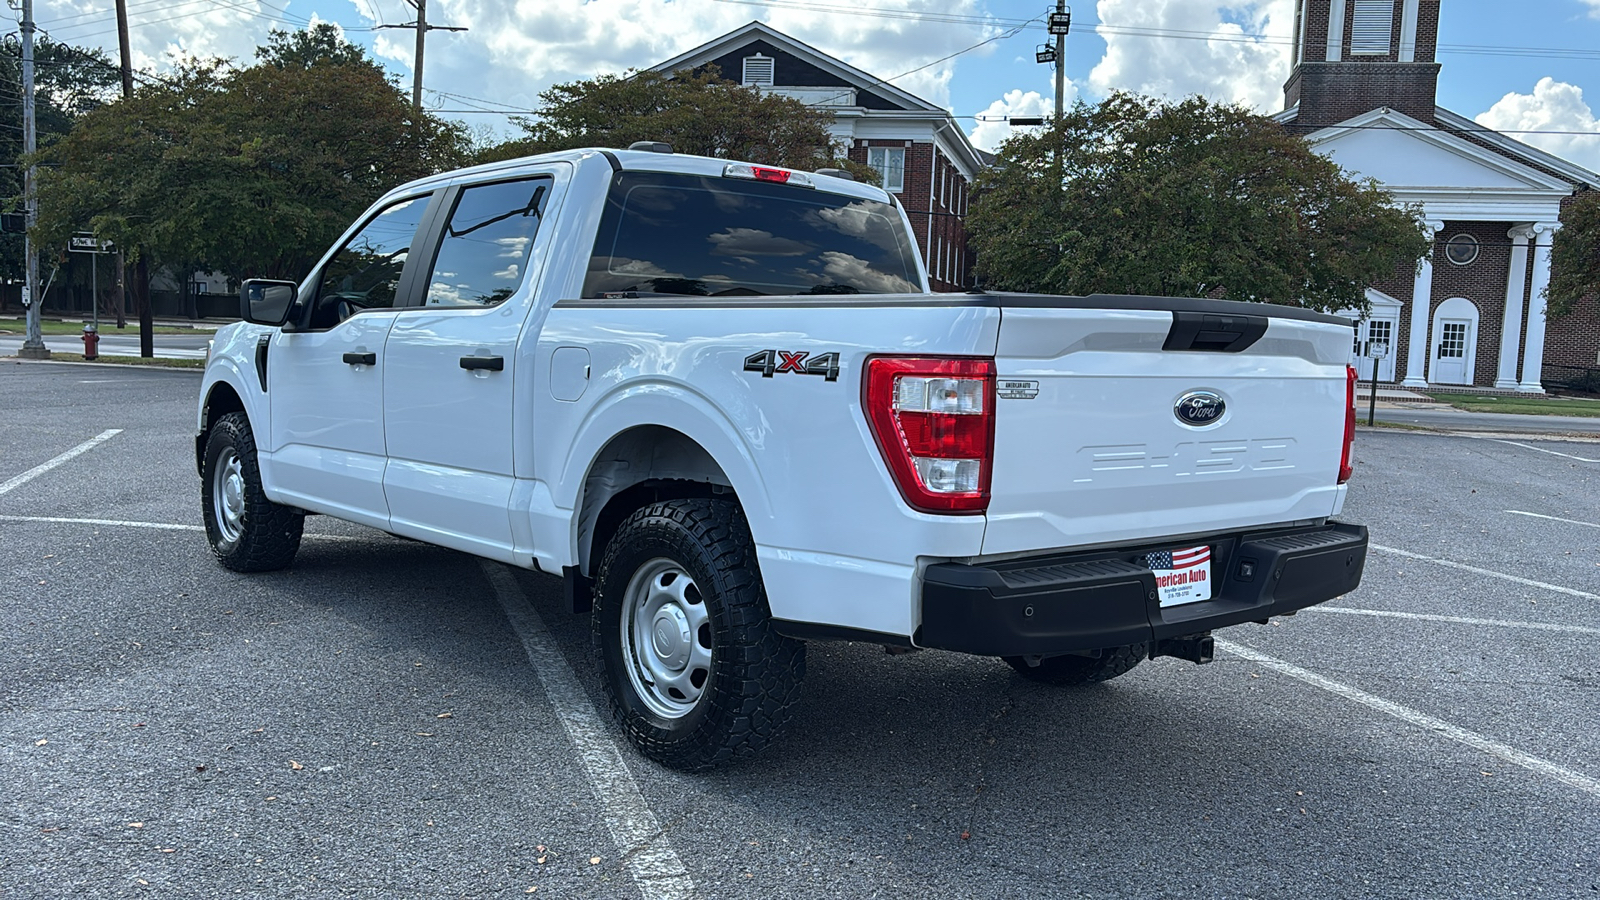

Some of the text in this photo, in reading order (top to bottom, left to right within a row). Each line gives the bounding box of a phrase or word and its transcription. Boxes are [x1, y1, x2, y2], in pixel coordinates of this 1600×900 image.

[1188, 398, 1217, 418] Ford
[1156, 569, 1206, 588] merican Auto
